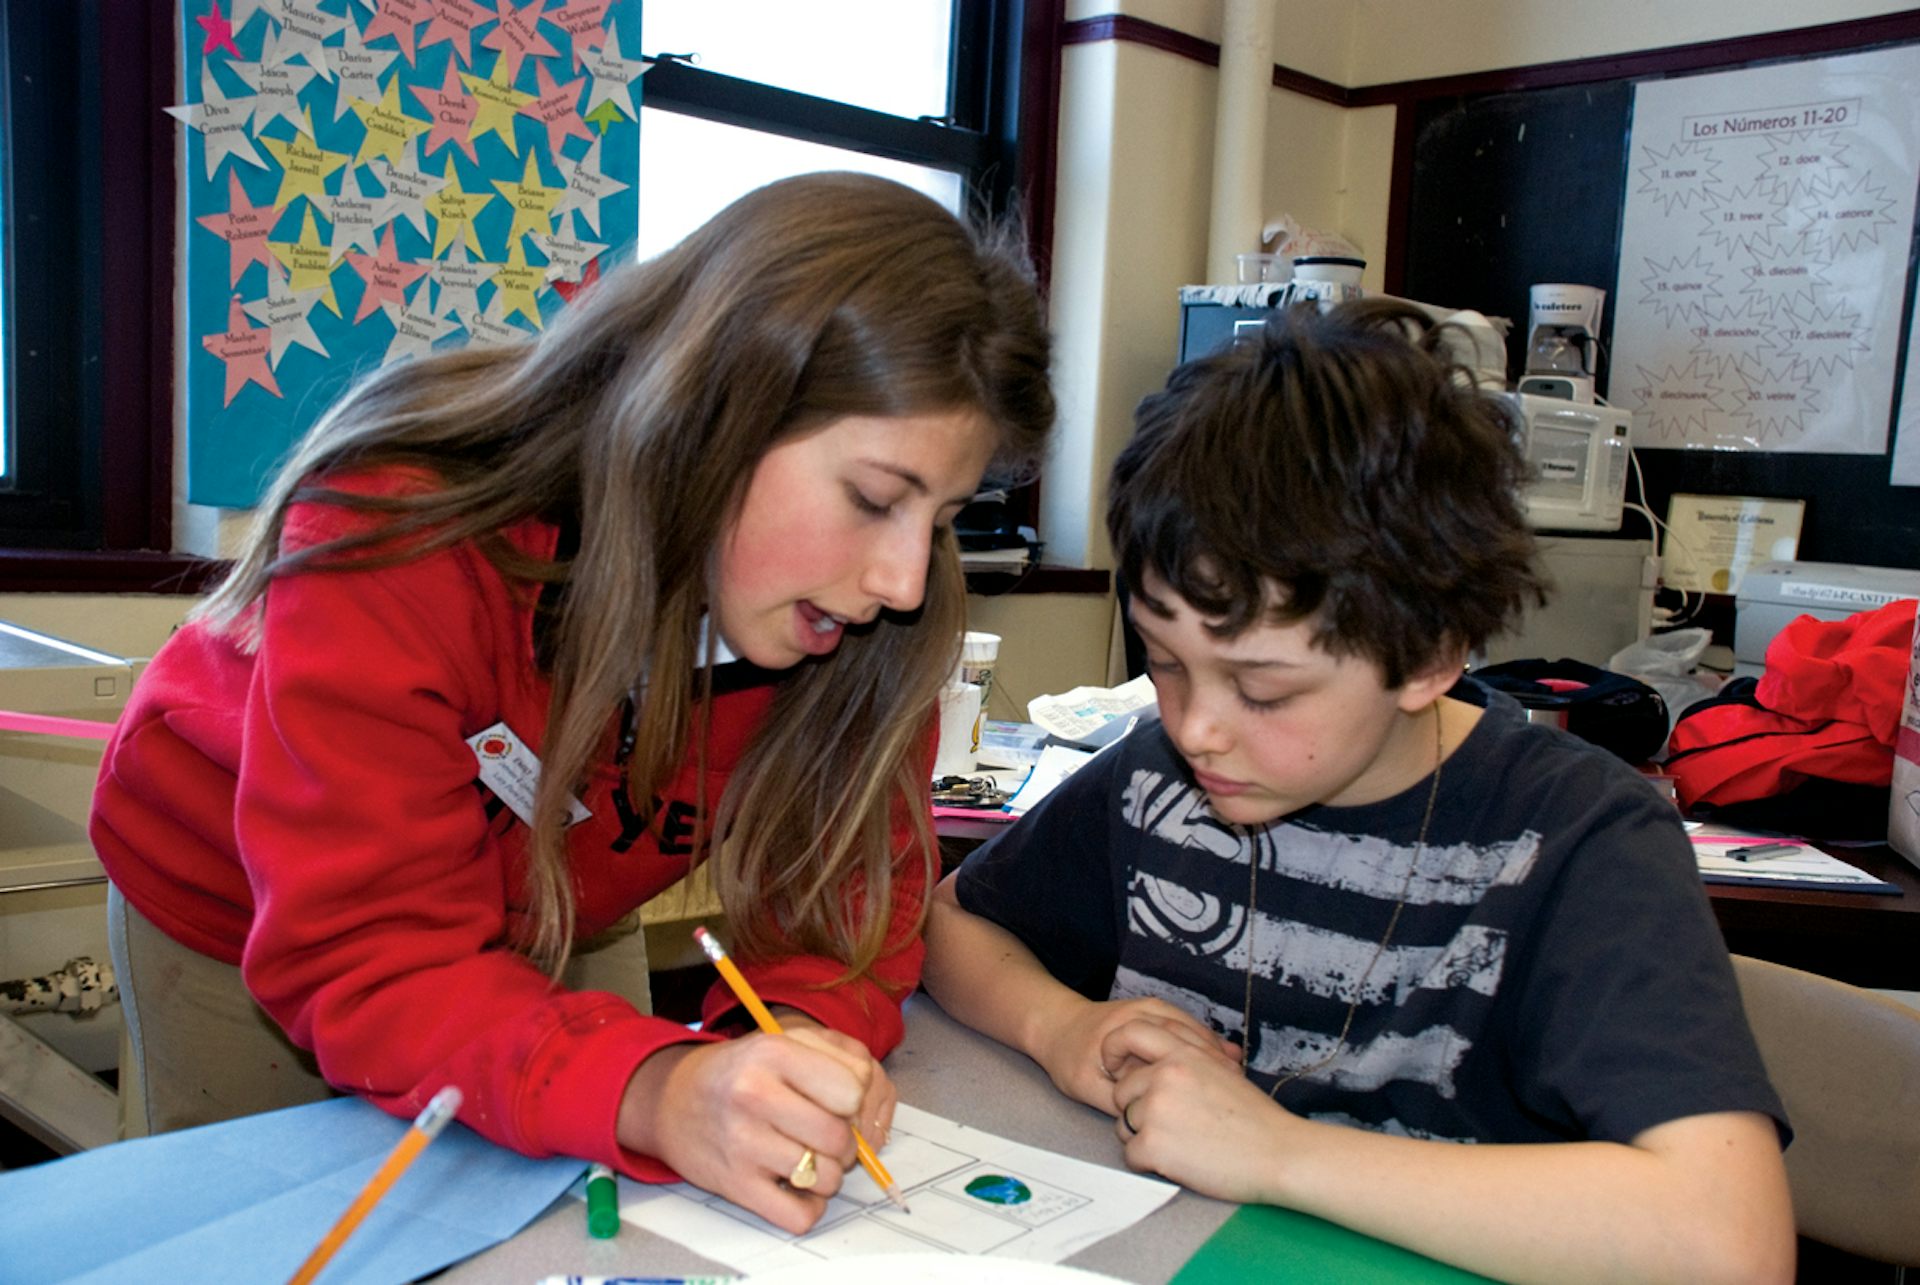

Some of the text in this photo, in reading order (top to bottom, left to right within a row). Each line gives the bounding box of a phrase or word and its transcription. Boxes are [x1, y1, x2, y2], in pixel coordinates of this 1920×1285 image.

[282, 17, 323, 40] Thomas
[259, 84, 294, 97] Joseph
[1693, 106, 1847, 138] Los Números 11-20
[286, 144, 323, 162] Richard
[1796, 153, 1821, 165] doce
[1675, 169, 1697, 178] once
[1740, 211, 1764, 222] trece
[1835, 209, 1873, 219] catorce
[225, 228, 268, 240] Robinson
[1672, 282, 1702, 293] quince
[1766, 390, 1796, 400] veinte
